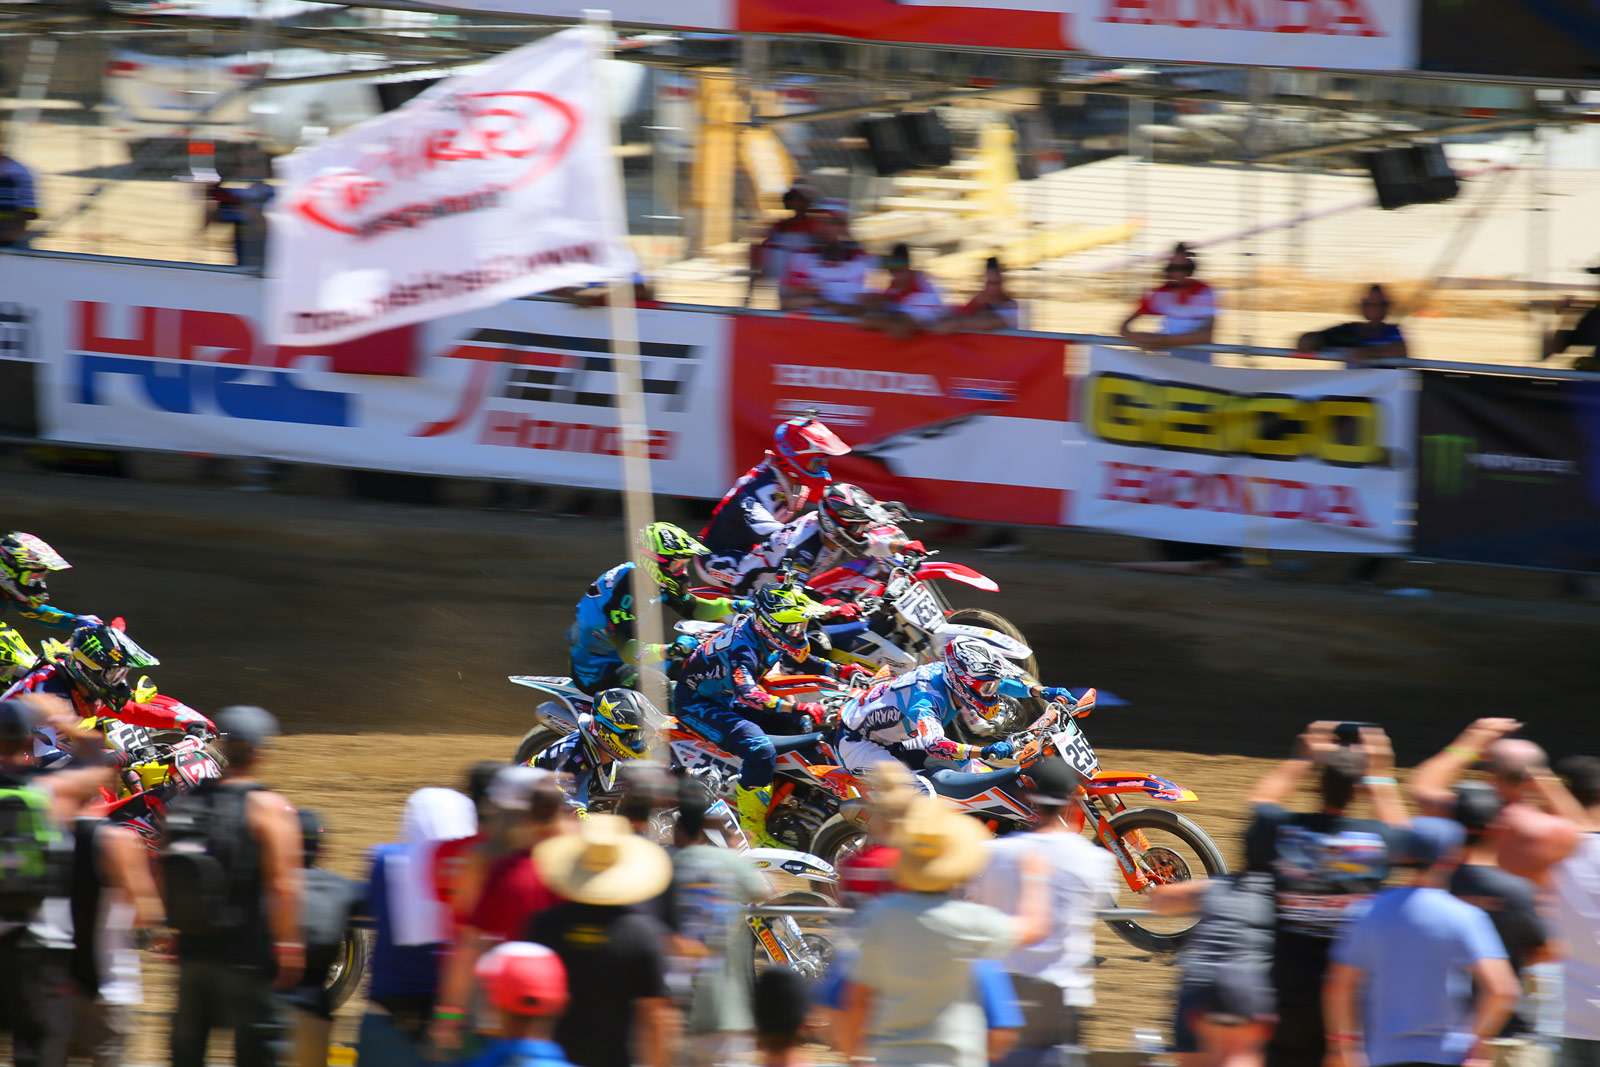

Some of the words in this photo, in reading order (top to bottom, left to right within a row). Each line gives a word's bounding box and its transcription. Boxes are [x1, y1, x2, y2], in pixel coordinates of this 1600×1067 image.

[1097, 460, 1376, 528] HONDA
[947, 654, 977, 686] 100%
[1107, 839, 1134, 874] MOTOREX
